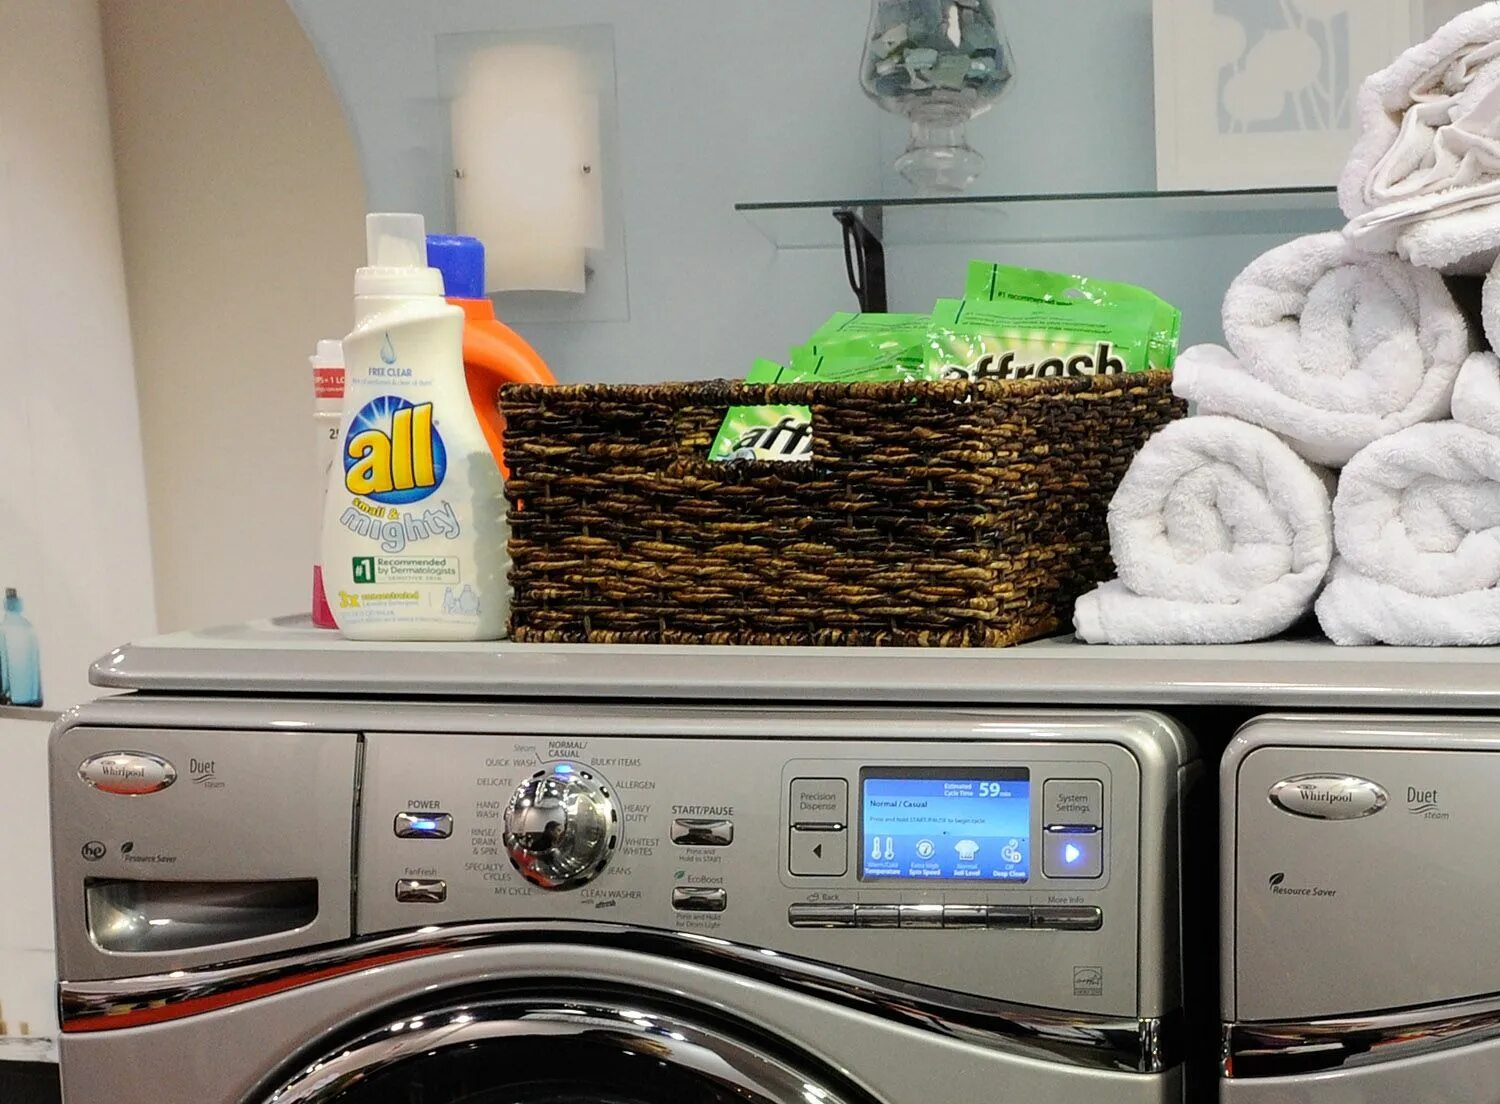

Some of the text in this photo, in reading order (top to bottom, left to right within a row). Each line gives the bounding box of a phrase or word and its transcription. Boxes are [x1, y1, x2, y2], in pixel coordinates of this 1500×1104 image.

[369, 368, 412, 377] FREE CLEAR
[345, 402, 434, 496] all
[352, 497, 400, 520] small &
[340, 503, 460, 554] mighty
[378, 558, 446, 566] Recommended
[355, 558, 372, 581] #1
[378, 566, 456, 576] by Dermatologists
[548, 741, 588, 750] NORMAL/
[548, 750, 580, 758] CASUAL
[190, 758, 215, 774] Duet
[485, 758, 536, 767] QUICK WASH
[591, 758, 642, 767] BULKY ITEMS
[102, 766, 144, 780] Whirlpool
[477, 778, 512, 786] DELICATE
[615, 781, 656, 790] ALLERGEN
[979, 783, 1001, 797] 59
[800, 792, 836, 800] Precision
[1058, 794, 1088, 804] System
[1300, 790, 1352, 804] Whirlpool
[1407, 786, 1438, 804] Duet
[408, 800, 440, 809] POWER
[476, 801, 500, 809] HAND
[800, 802, 836, 810] Dispense
[870, 800, 898, 808] Normal
[1056, 804, 1090, 813] Settings
[624, 805, 651, 813] HEAVY
[672, 805, 734, 816] START/PAUSE
[625, 814, 648, 822] DUTY
[1424, 811, 1450, 820] steam
[471, 838, 497, 846] DRAIN
[625, 838, 659, 847] WHITEST
[624, 847, 652, 856] WHITES
[125, 855, 177, 864] Resource Saver
[405, 867, 437, 876] FanFresh
[465, 863, 504, 872] SPECIALTY
[607, 867, 632, 876] JEANS
[483, 872, 512, 882] CYCLES
[688, 875, 723, 884] EcoBoost
[494, 887, 532, 896] MY CYCLE
[580, 889, 642, 899] CLEAN WASHER
[1273, 886, 1336, 898] Resource Saver
[1048, 896, 1067, 904] More
